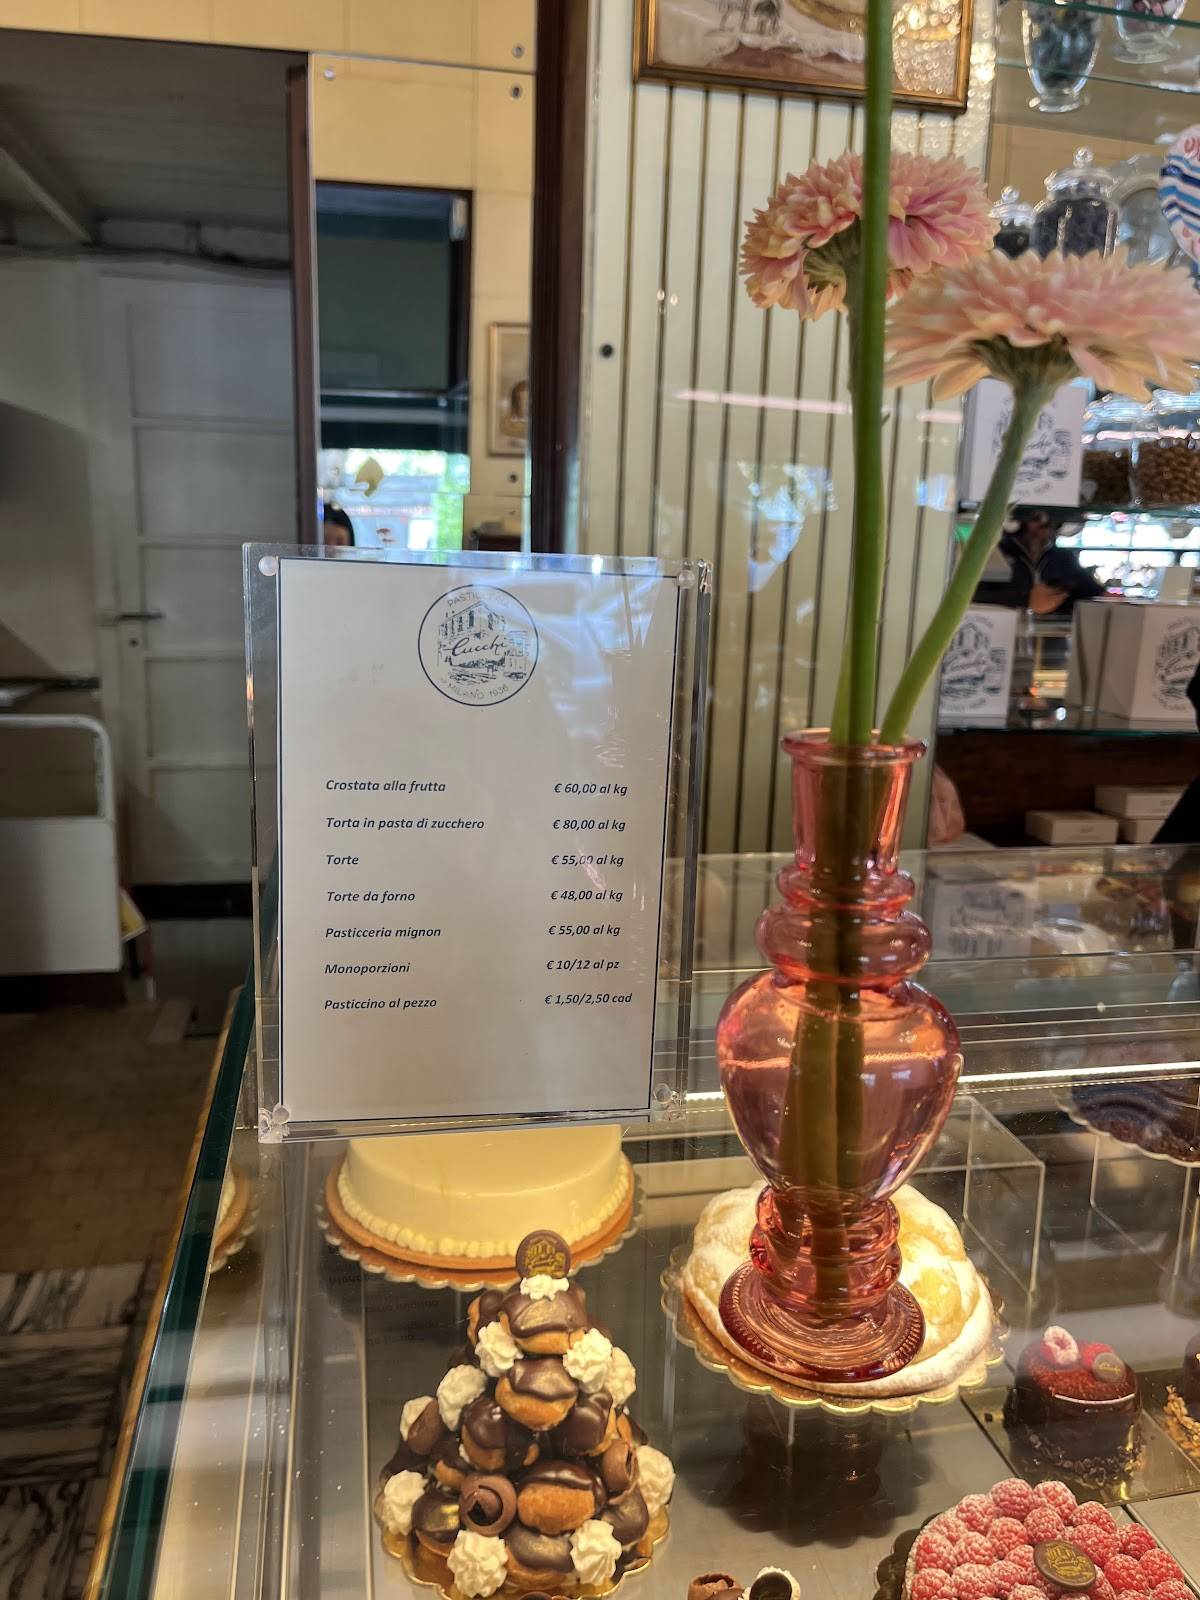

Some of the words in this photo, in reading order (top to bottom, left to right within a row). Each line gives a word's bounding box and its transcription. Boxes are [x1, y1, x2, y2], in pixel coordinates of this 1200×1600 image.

[451, 635, 507, 657] Cucchi
[325, 779, 380, 791] Crostata
[383, 780, 406, 791] alla
[408, 780, 447, 794] frutta
[553, 783, 563, 793] €
[564, 783, 597, 795] 60,00
[599, 783, 611, 794] al
[613, 783, 628, 797] kg
[325, 817, 360, 829] Torta
[363, 817, 376, 829] in
[377, 819, 414, 831] pasta
[416, 817, 429, 829] di
[431, 817, 485, 830] zucchero
[552, 819, 561, 830] €
[562, 819, 595, 831] 80,00
[598, 819, 609, 830] al
[611, 819, 627, 832] kg
[326, 854, 360, 866] Torte
[551, 855, 560, 865] €
[561, 855, 594, 866] 55,00
[596, 854, 608, 865] al
[609, 854, 625, 868] kg
[327, 891, 360, 902] Torte
[362, 891, 379, 902] da
[380, 891, 416, 904] forno
[550, 890, 559, 901] €
[560, 890, 593, 902] 48,00
[595, 890, 606, 901] al
[608, 890, 624, 903] kg
[325, 926, 392, 938] Pasticceria
[395, 926, 442, 940] mignon
[548, 925, 557, 936] €
[557, 924, 590, 937] 55,00
[593, 924, 604, 935] al
[606, 924, 621, 937] kg
[324, 961, 411, 977] Monoporzioni
[546, 960, 555, 971] €
[556, 959, 591, 972] 10/12
[593, 960, 604, 970] al
[605, 960, 620, 972] pz
[324, 998, 386, 1011] Pasticcino
[388, 998, 401, 1009] al
[402, 999, 438, 1012] pezzo
[544, 995, 553, 1005] €
[554, 993, 610, 1006] 1,50/2,50
[611, 993, 633, 1004] cad
